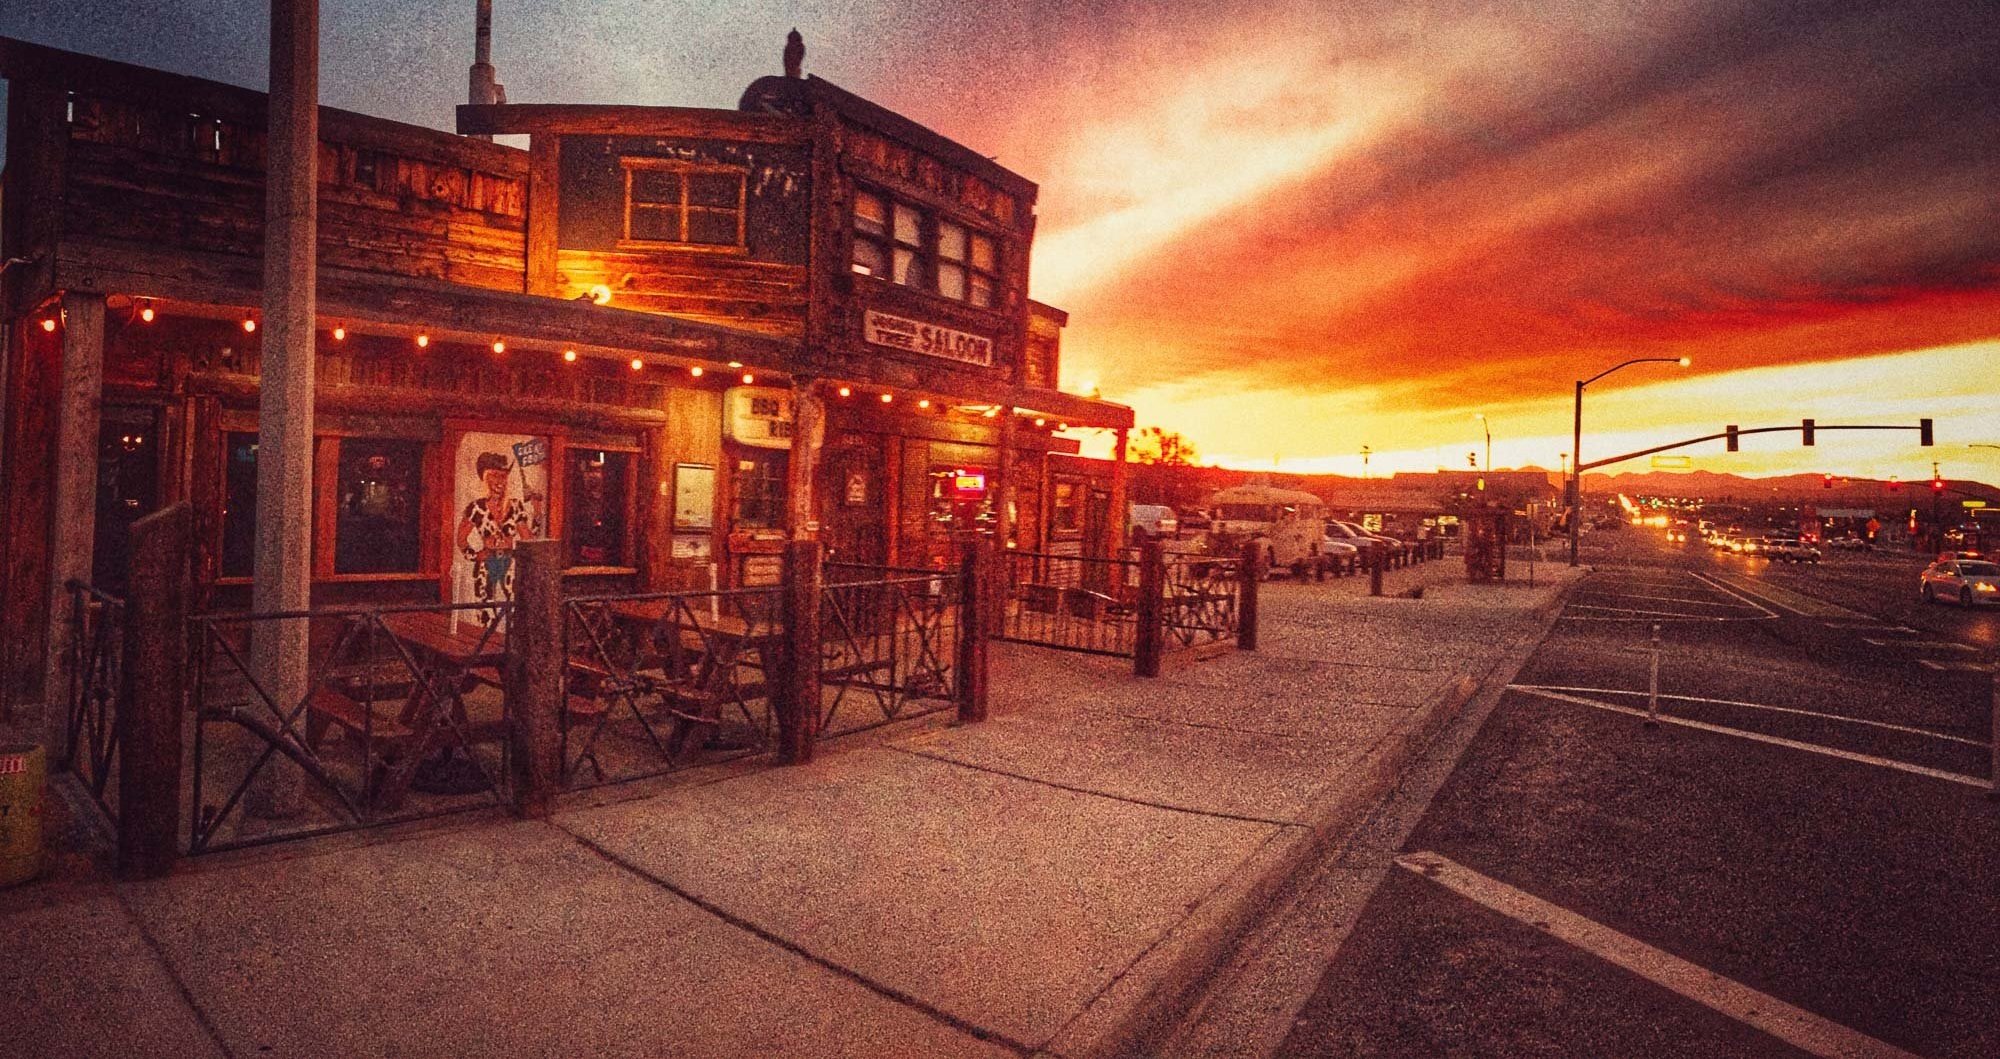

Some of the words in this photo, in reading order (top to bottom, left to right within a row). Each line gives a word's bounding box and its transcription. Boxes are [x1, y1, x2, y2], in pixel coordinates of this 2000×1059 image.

[876, 329, 914, 349] TREE
[919, 326, 988, 364] SALOON
[752, 398, 780, 417] BBQ
[769, 421, 792, 438] RIB
